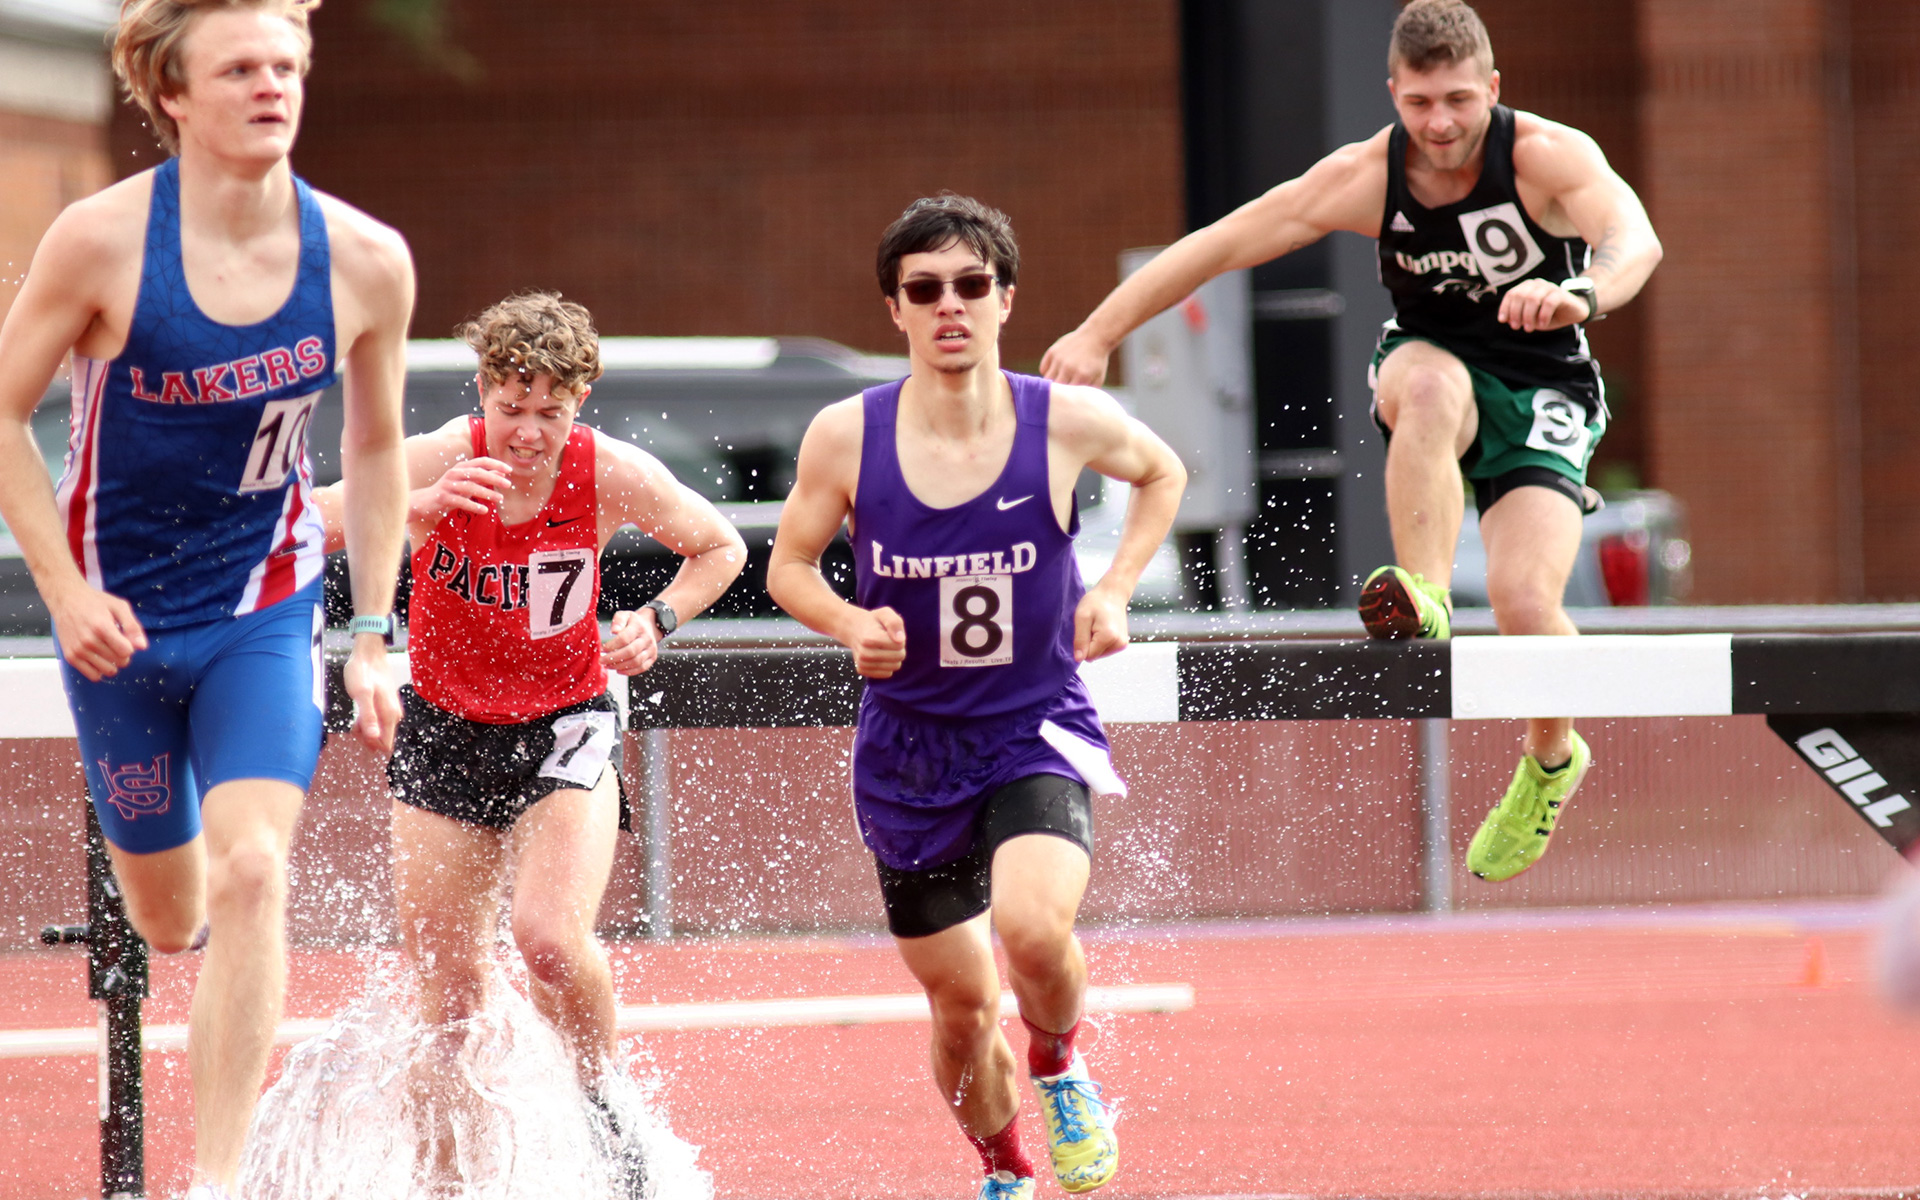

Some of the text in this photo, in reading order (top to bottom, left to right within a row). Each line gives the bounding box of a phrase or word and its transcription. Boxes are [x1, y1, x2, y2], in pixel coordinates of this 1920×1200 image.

[1476, 219, 1528, 273] 9
[130, 335, 326, 405] LAKERS
[256, 402, 312, 480] 10
[538, 558, 586, 627] 7
[872, 540, 1037, 579] LINFIELD
[951, 585, 1003, 658] 8
[1797, 727, 1912, 828] GILL
